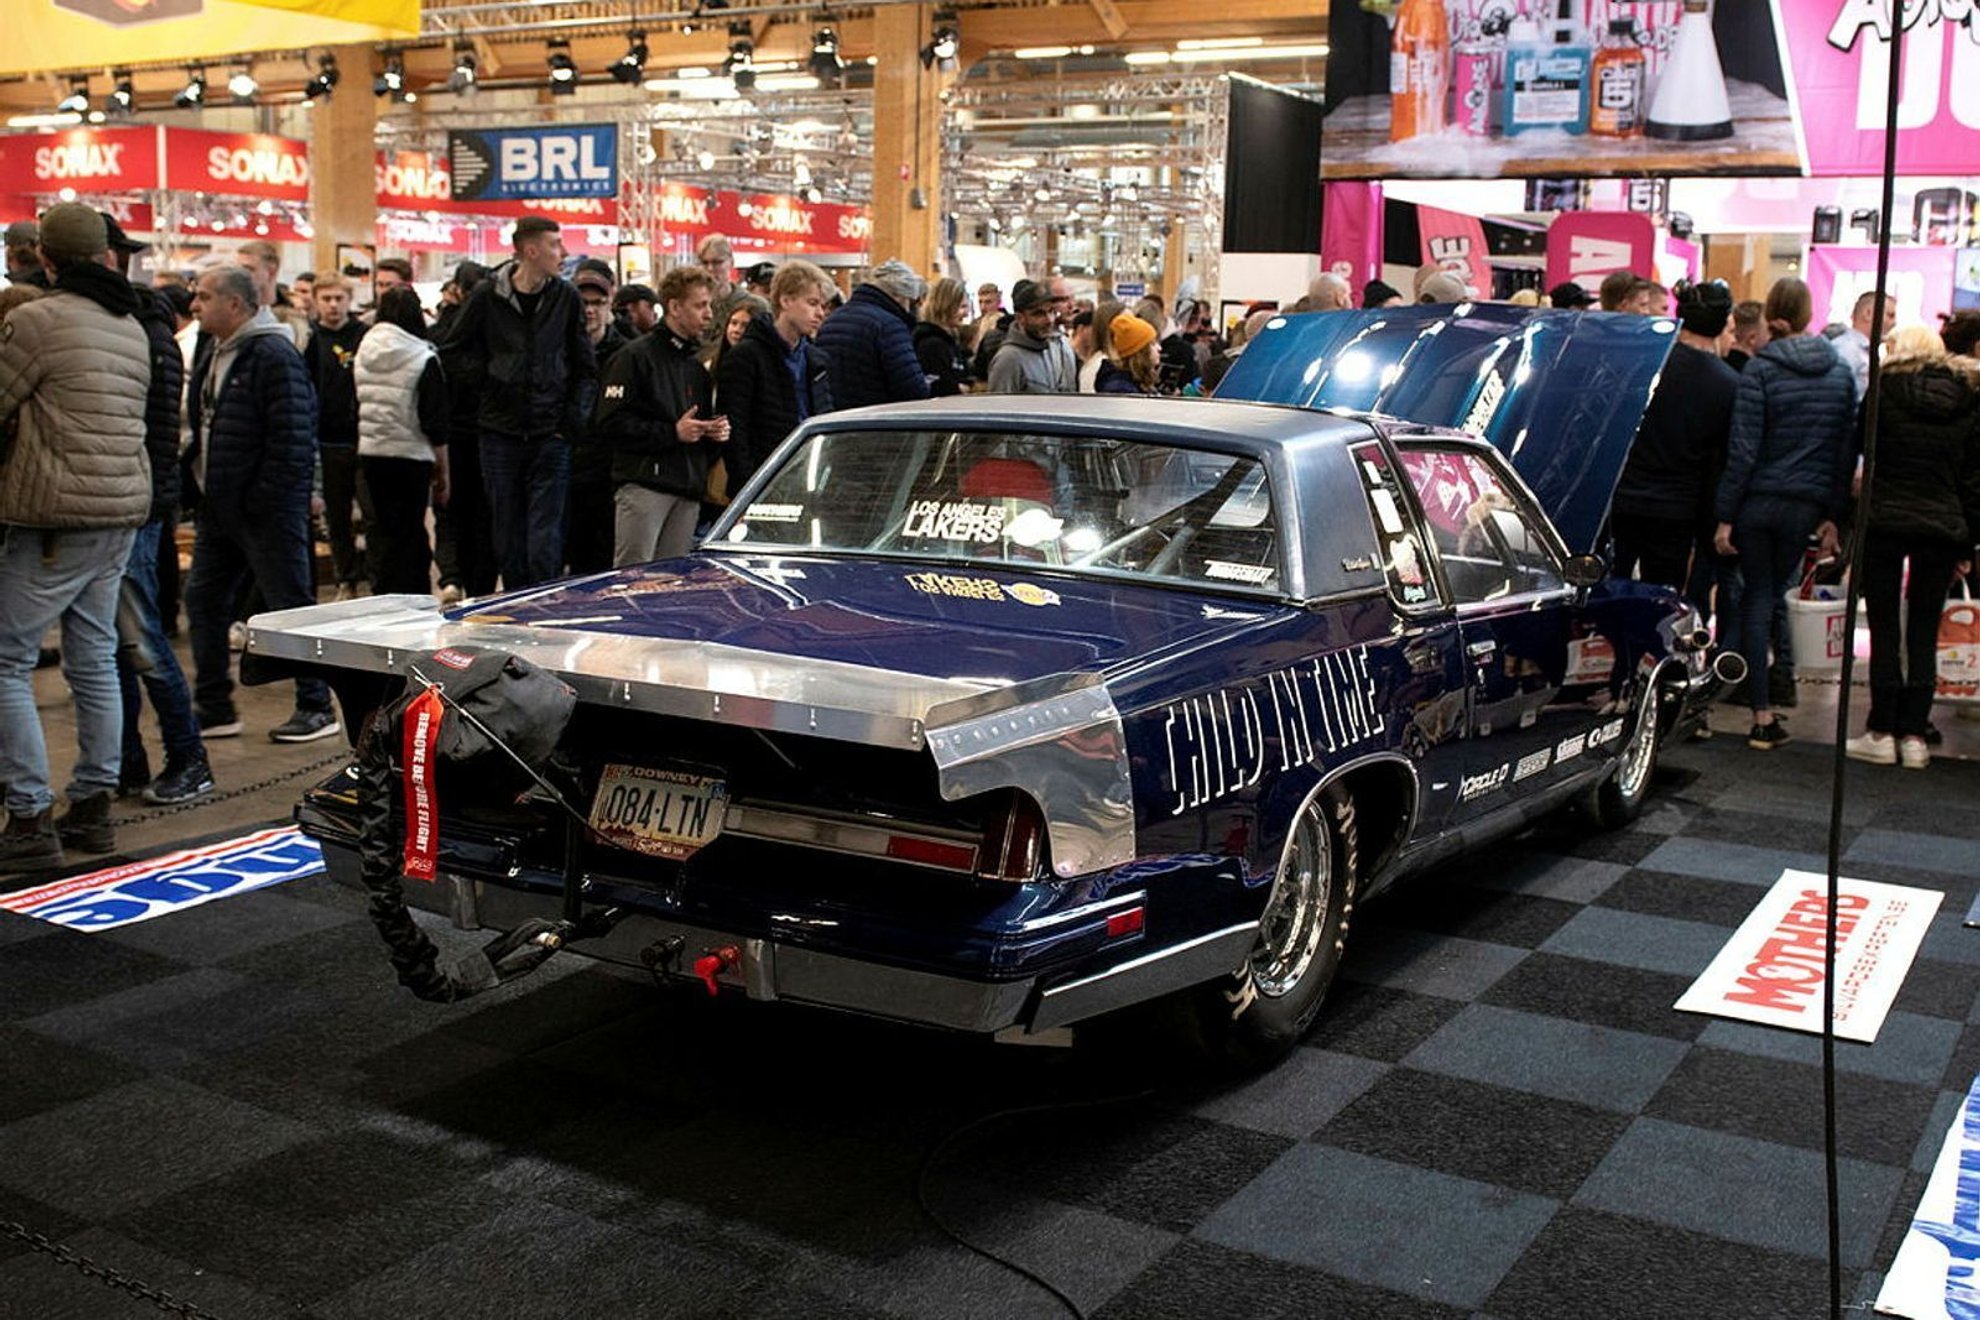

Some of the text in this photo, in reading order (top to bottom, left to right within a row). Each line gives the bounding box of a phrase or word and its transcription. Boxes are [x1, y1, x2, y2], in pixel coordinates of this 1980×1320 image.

[35, 144, 121, 179] SONAX
[501, 135, 610, 181] BRL
[751, 204, 813, 234] SONAX
[902, 512, 1002, 543] LAKERS
[911, 500, 1007, 521] LOS ANGELES
[1306, 643, 1385, 753] TIME
[413, 713, 431, 764] REMOVE
[411, 763, 430, 810] BEFORE
[416, 809, 430, 854] FLIGHT
[1722, 888, 1871, 1014] MOTHERS
